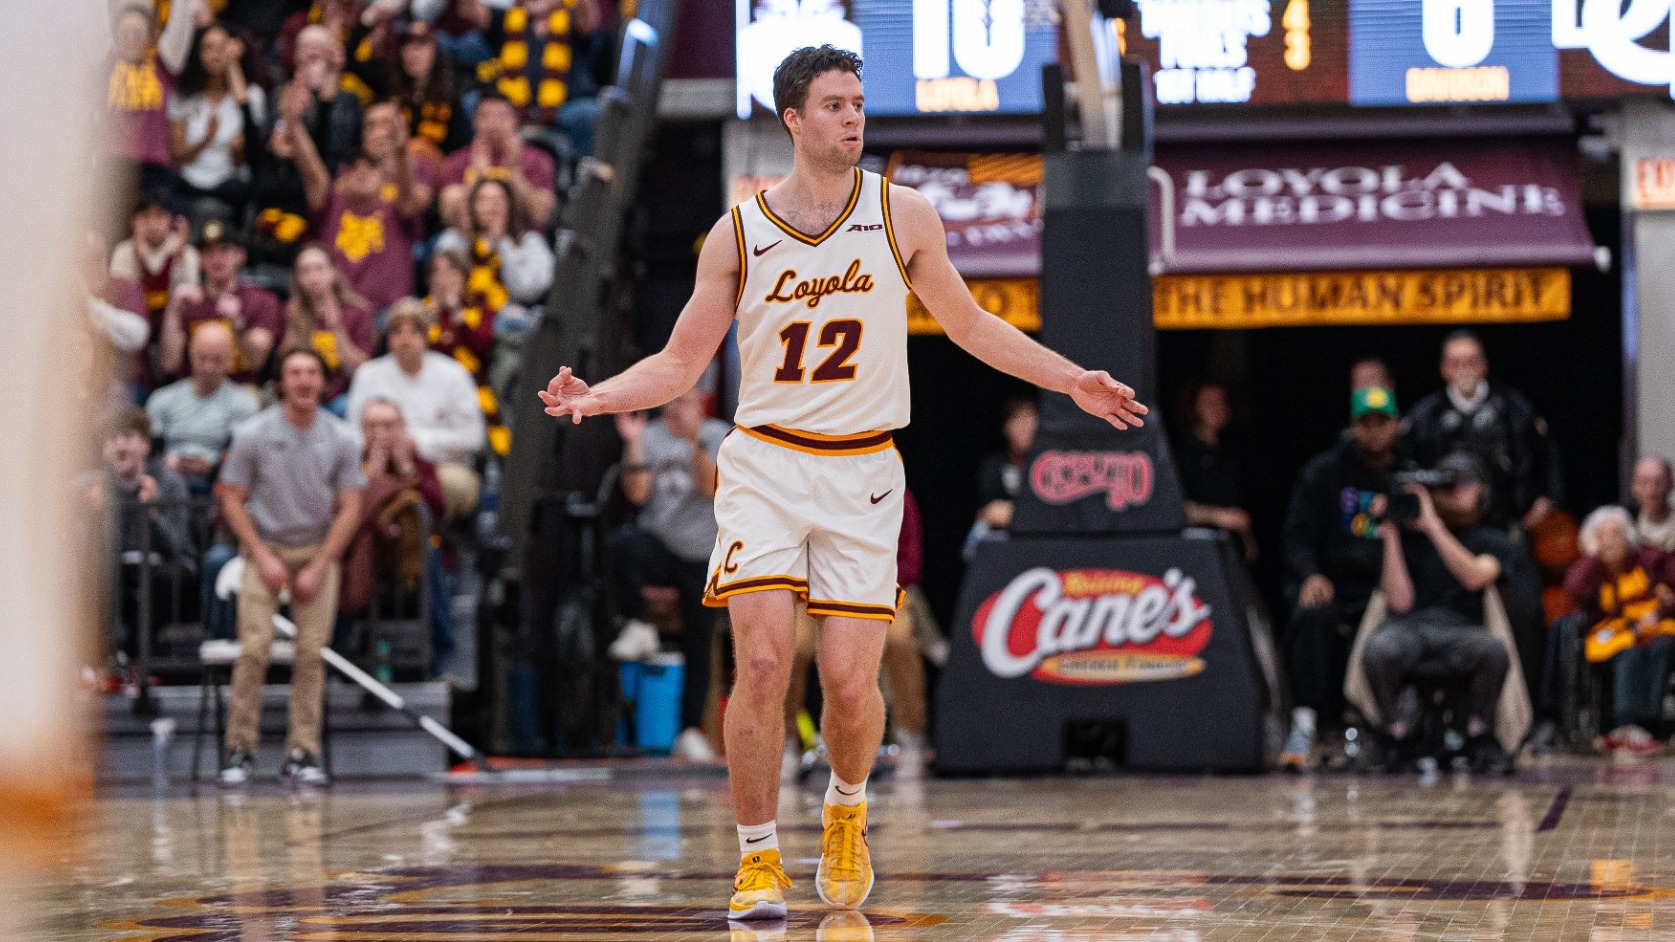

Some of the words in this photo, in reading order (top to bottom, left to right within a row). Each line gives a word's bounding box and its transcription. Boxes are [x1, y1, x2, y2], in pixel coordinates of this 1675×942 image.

[1184, 163, 1471, 197] LOYOLA
[1181, 186, 1565, 225] MEDICINE
[764, 258, 875, 309] Loyola
[1158, 280, 1224, 318] THE
[1243, 276, 1404, 316] HUMAN
[1416, 273, 1552, 312] SPIRIT
[773, 317, 864, 384] 12
[980, 566, 1213, 679] Cane's
